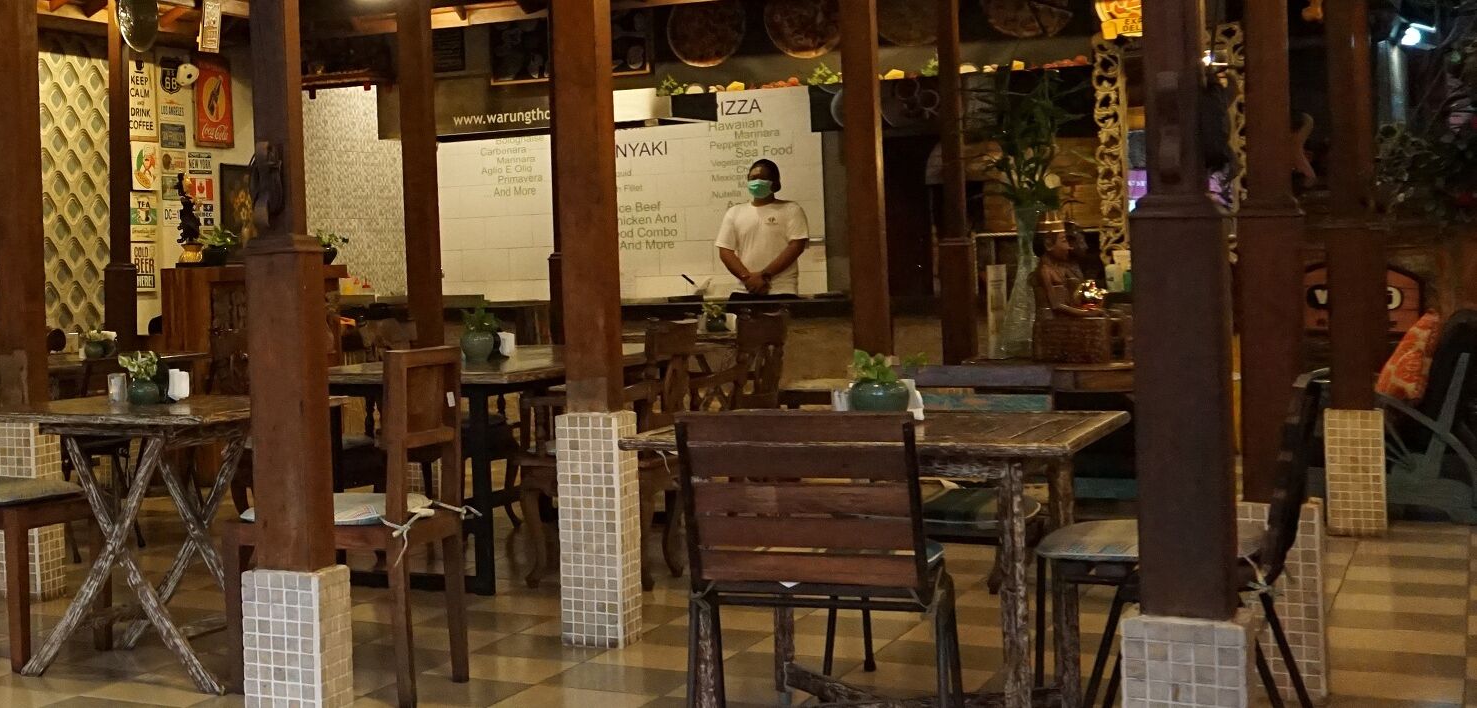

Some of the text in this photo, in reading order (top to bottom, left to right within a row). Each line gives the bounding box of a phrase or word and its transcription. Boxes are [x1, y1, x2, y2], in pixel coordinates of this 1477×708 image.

[130, 76, 149, 86] KEEP
[130, 88, 150, 98] CALM
[169, 106, 184, 117] ANGELES
[718, 98, 762, 116] IZZA
[130, 108, 151, 118] DRINK
[129, 120, 154, 131] COFFEE
[708, 119, 764, 132] Hawaiian
[480, 146, 527, 156] Carbonara
[709, 140, 758, 151] Pepperoni
[735, 144, 793, 158] Sea Food
[188, 159, 198, 169] NEW
[200, 159, 211, 169] YORK
[482, 166, 503, 175] Aglio
[498, 175, 543, 184] Primavera
[493, 186, 536, 197] And More
[137, 201, 150, 209] TEA
[635, 201, 661, 212] Beef
[655, 213, 677, 223] And
[637, 227, 678, 238] Combo
[620, 240, 675, 250] And More
[134, 246, 149, 258] COLD
[134, 258, 155, 274] BEER
